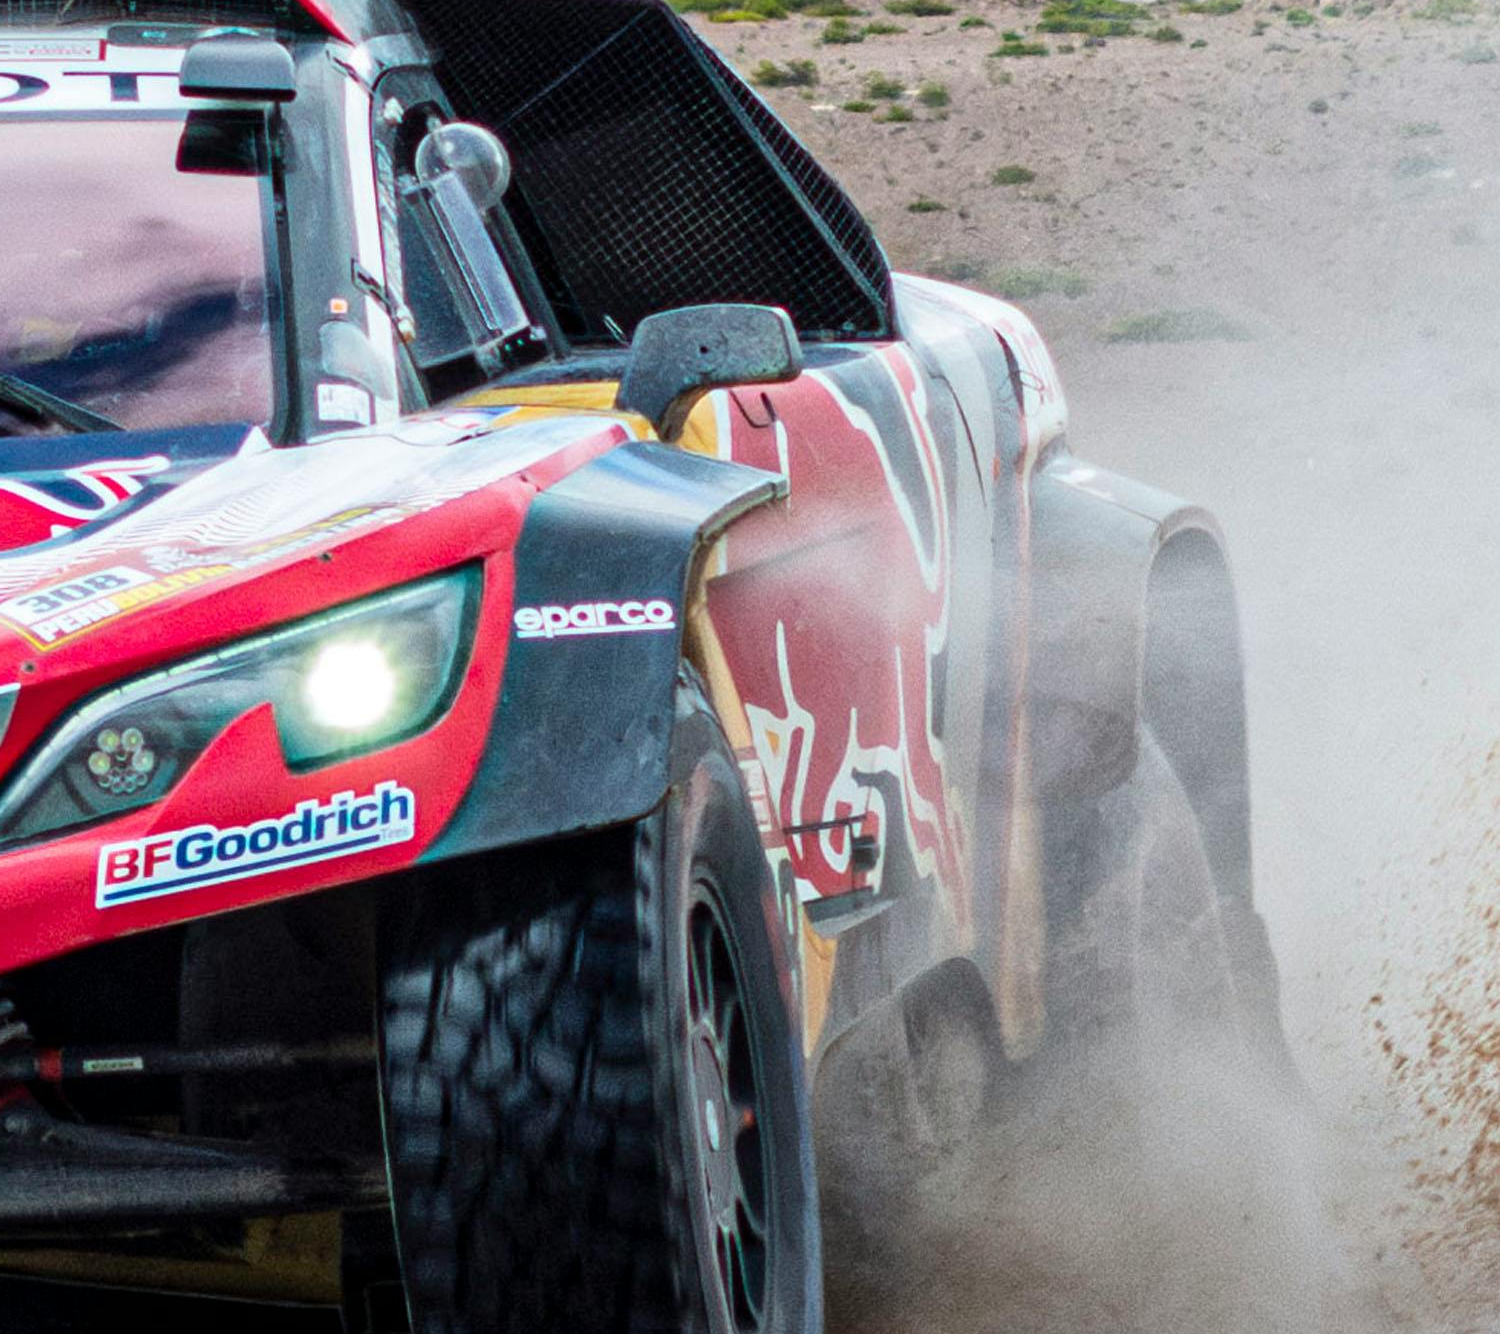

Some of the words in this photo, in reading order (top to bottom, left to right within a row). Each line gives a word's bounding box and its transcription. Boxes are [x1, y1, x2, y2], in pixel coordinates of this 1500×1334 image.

[16, 573, 131, 615] 308
[513, 599, 675, 638] sparco
[103, 788, 410, 887] BFGoodrich
